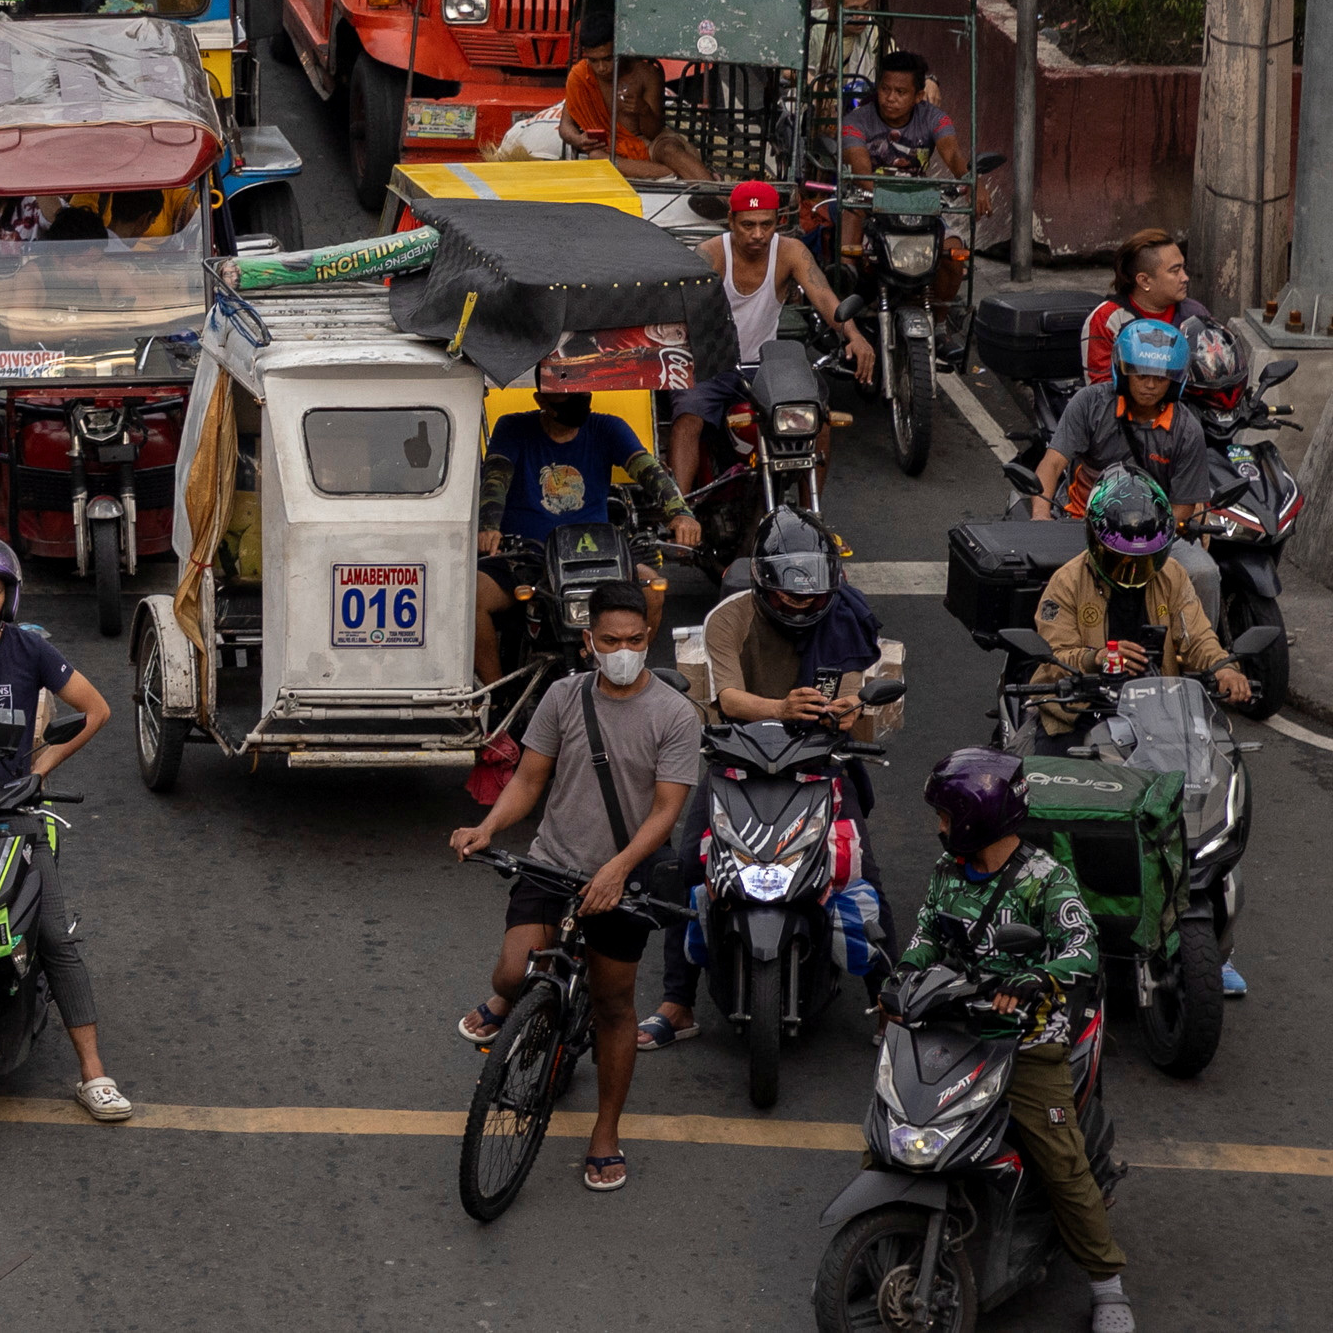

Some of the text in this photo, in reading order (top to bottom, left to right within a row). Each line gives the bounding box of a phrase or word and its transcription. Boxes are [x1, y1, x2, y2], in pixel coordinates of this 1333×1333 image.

[316, 239, 405, 280] MILLION!
[1139, 351, 1171, 362] ANGKAS
[340, 568, 418, 585] LAMABENTODA
[342, 588, 417, 629] 016
[1026, 773, 1123, 792] Grab
[970, 1137, 993, 1162] HONDA
